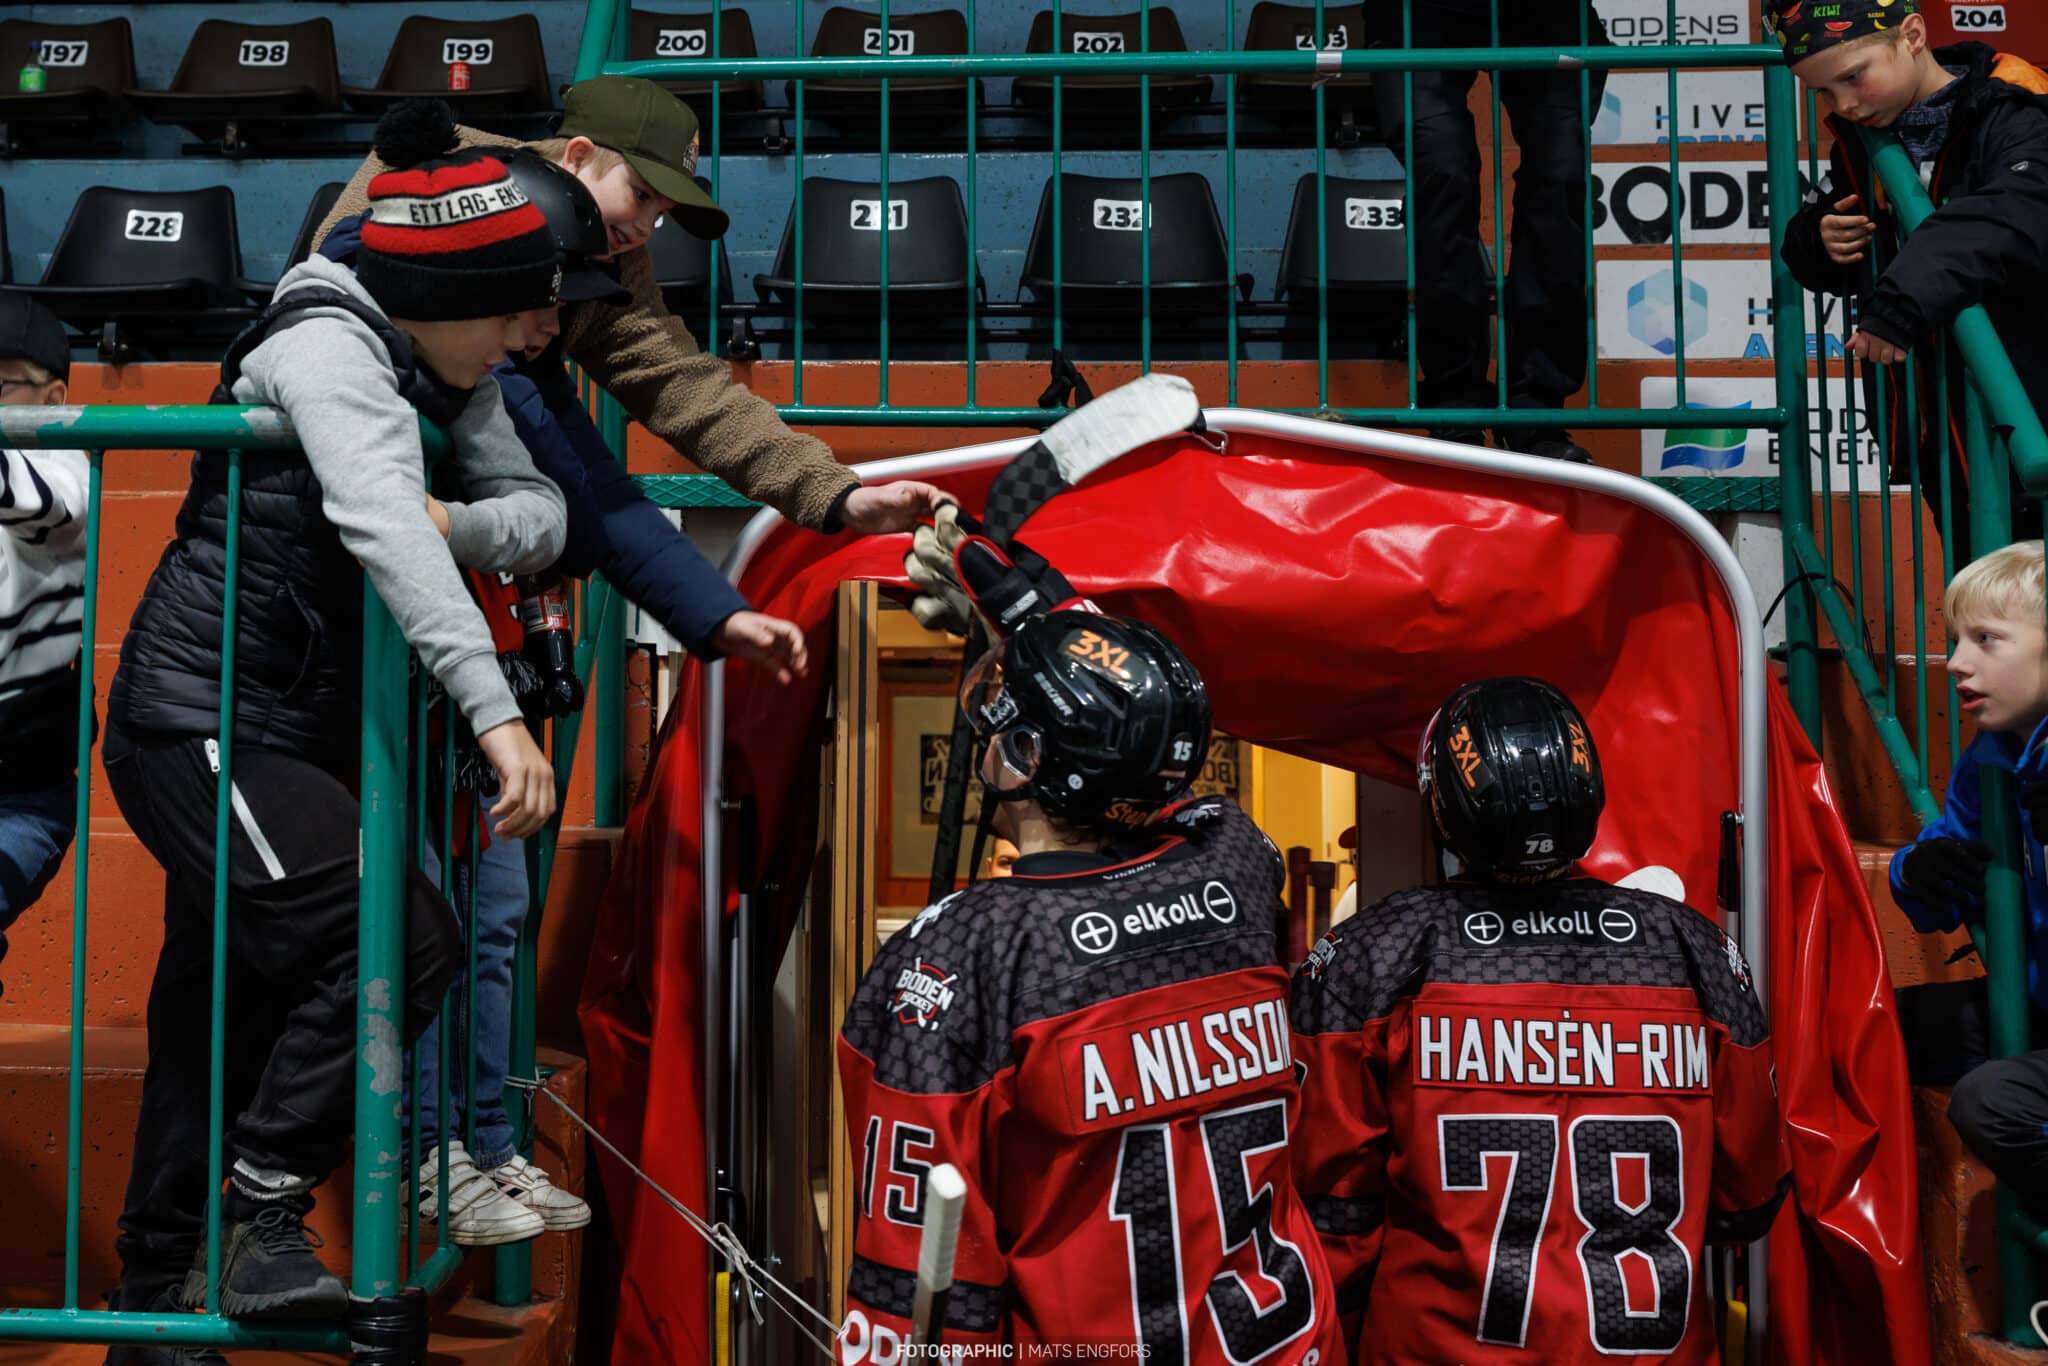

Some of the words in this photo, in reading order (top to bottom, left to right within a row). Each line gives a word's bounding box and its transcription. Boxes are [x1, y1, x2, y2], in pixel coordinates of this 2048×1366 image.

[1954, 10, 2004, 27] 204
[42, 44, 86, 63] 197
[242, 44, 285, 62] 198
[446, 43, 490, 61] 199
[657, 35, 705, 51] 200
[1077, 36, 1123, 53] 202
[1655, 104, 1765, 130] HIVE
[408, 203, 443, 224] ETT
[1349, 205, 1402, 227] 233
[128, 215, 180, 238] 228
[1067, 629, 1133, 680] 3XL
[1172, 740, 1194, 761] 15
[1449, 725, 1482, 789] 3XL
[1524, 839, 1555, 855] 78
[1123, 893, 1206, 935] elkoll
[1511, 910, 1594, 937] elkoll
[896, 968, 955, 1012] BODEN
[862, 1113, 937, 1228] 15
[1108, 1096, 1316, 1366] 15
[1437, 1113, 1692, 1355] 78
